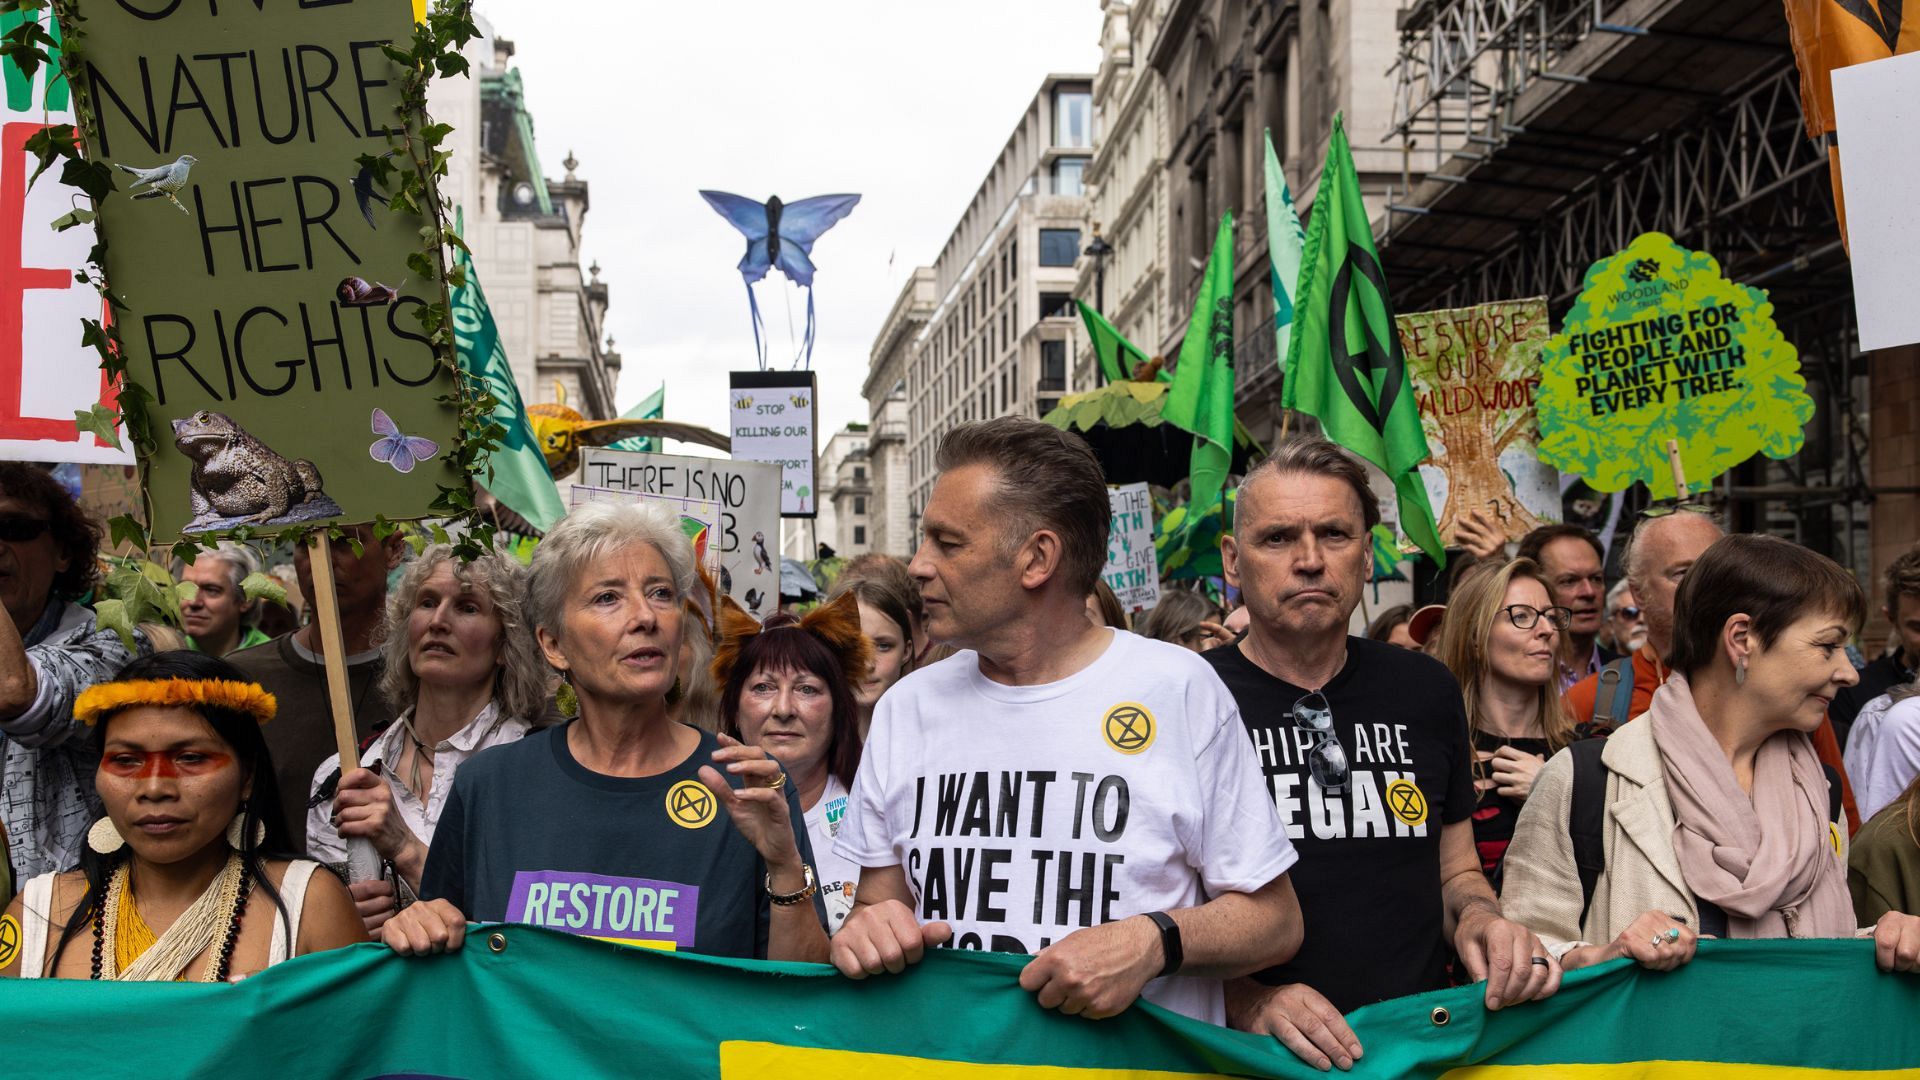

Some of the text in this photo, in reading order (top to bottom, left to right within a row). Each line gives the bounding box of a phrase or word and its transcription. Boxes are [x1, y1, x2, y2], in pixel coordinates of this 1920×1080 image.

[86, 40, 406, 158] NATURE
[193, 175, 362, 276] HER
[1608, 278, 1689, 304] WOODLAND
[143, 294, 443, 405] RIGHTS
[1569, 303, 1740, 355] FIGHTING FOR
[1582, 327, 1732, 375] PEOPLE AND
[1436, 350, 1494, 381] OUR
[1575, 345, 1746, 397] PLANET WITH
[756, 404, 785, 415] STOP
[1590, 370, 1744, 416] EVERY TREE.
[735, 426, 808, 437] KILLING OUR
[588, 462, 746, 508] THERE IS NO
[1120, 489, 1149, 511] THE
[1110, 510, 1144, 535] RTH
[1101, 565, 1152, 590] IRTH!
[1126, 546, 1155, 569] GIVE
[1354, 723, 1414, 764] ARE
[825, 796, 848, 812] THINK
[909, 770, 1130, 843] I WANT TO
[1263, 770, 1428, 840] EGAN
[522, 882, 680, 933] RESTORE
[908, 847, 1125, 927] SAVE THE
